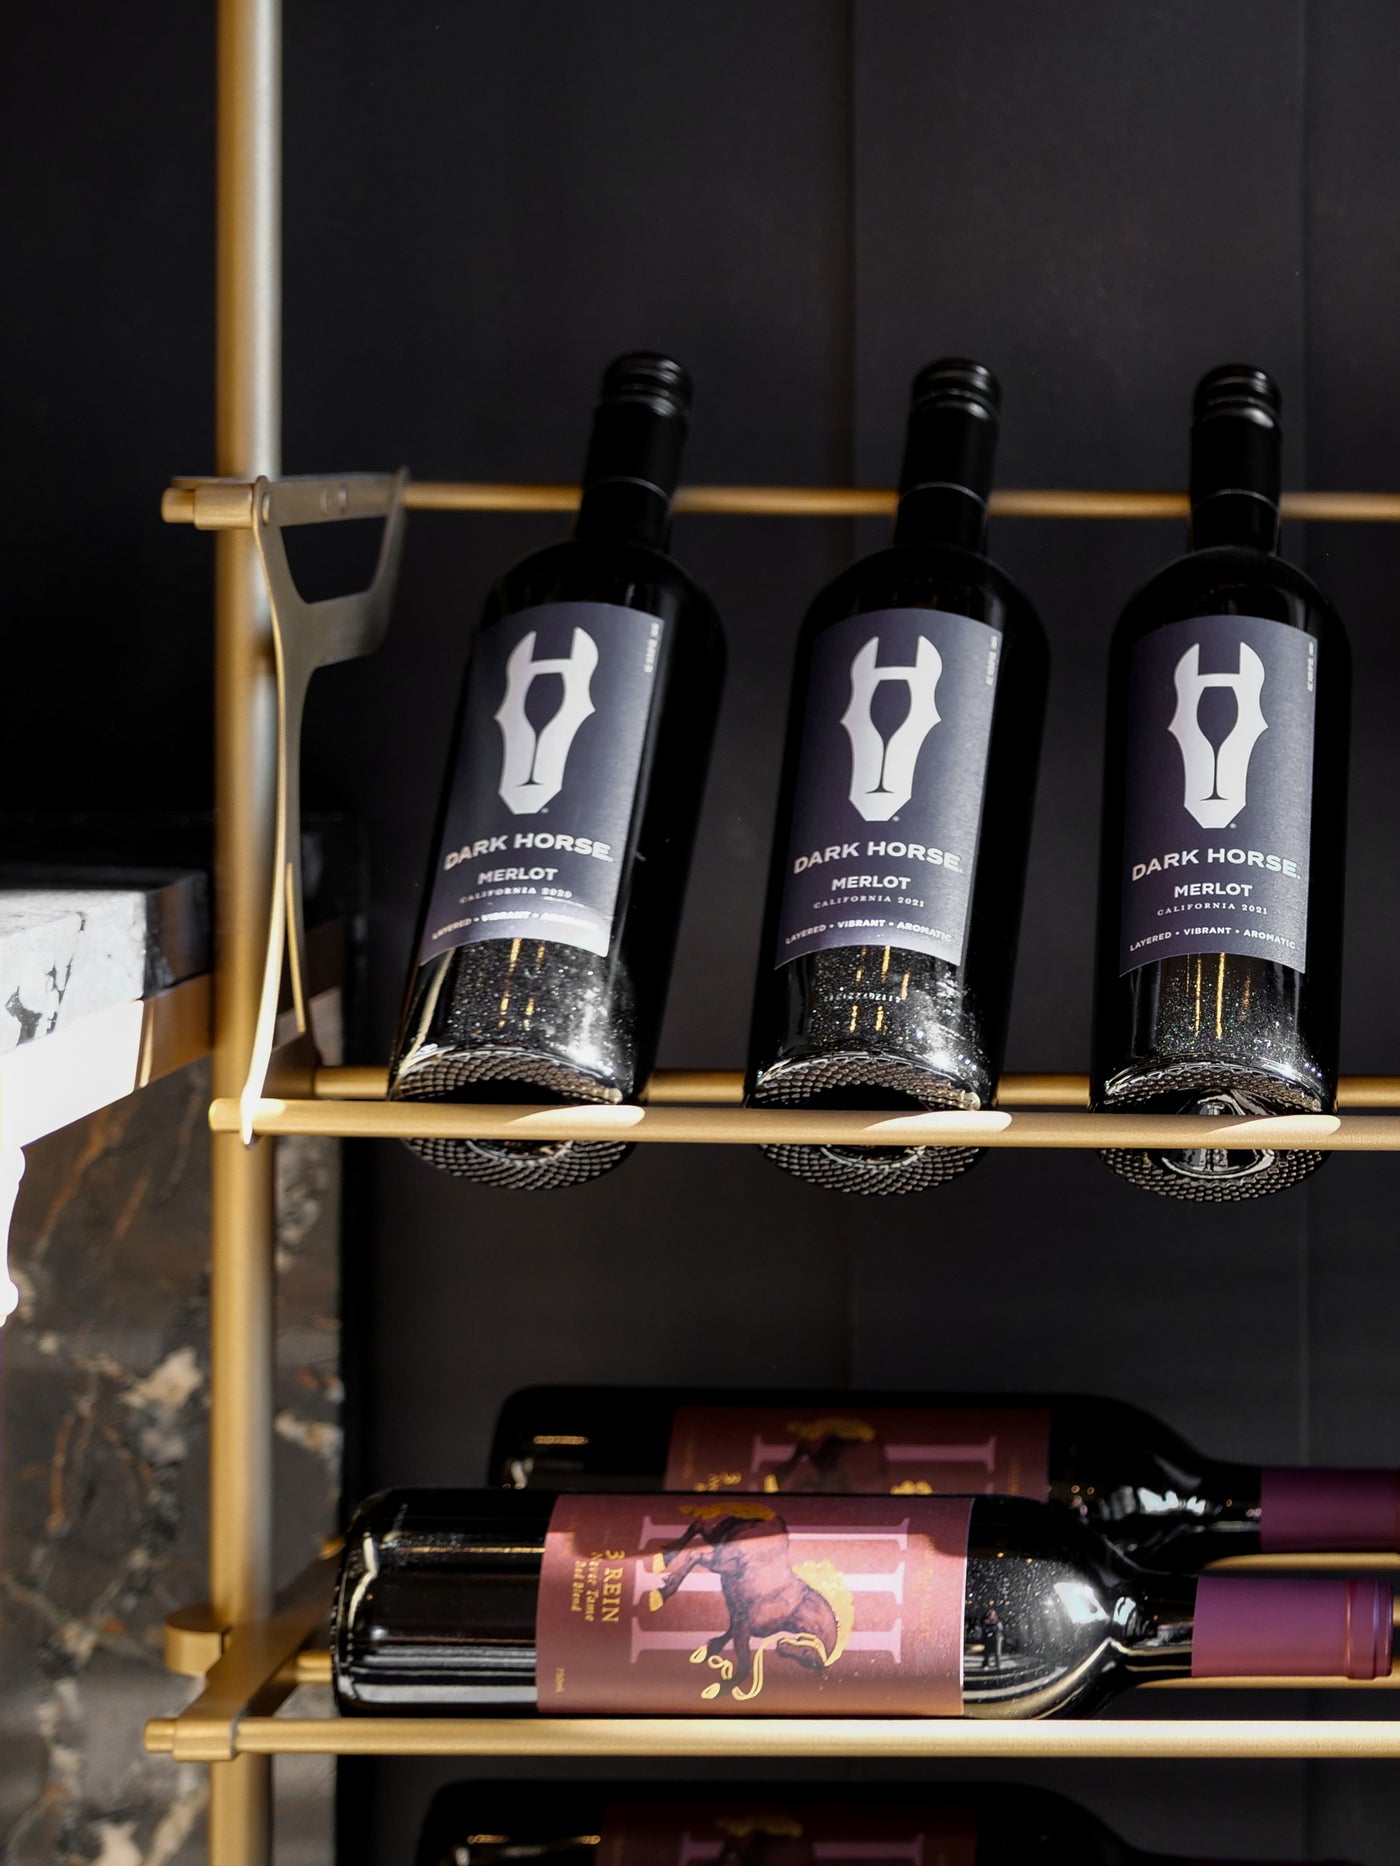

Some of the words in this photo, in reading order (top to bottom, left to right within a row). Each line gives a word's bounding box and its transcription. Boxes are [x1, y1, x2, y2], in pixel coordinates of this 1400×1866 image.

[444, 834, 508, 871] DARK
[794, 842, 859, 874] DARK
[1132, 849, 1199, 881] DARK
[478, 867, 558, 885] MERLOT
[831, 876, 911, 891] MERLOT
[459, 887, 537, 903] CALIFORNIA
[1174, 883, 1252, 898] MERLOT
[813, 896, 892, 909] CALIFORNIA
[898, 898, 924, 908] 2021
[1157, 902, 1236, 916] CALIFORNIA
[1242, 904, 1268, 914] 2021
[785, 924, 826, 944] LAYERED
[837, 919, 886, 929] VIBRANT
[1129, 931, 1172, 952] LAYERED
[1184, 927, 1231, 936] VIBRANT
[1243, 930, 1296, 949] AROMATIC
[606, 1549, 625, 1559] 3
[601, 1567, 624, 1623] REIN
